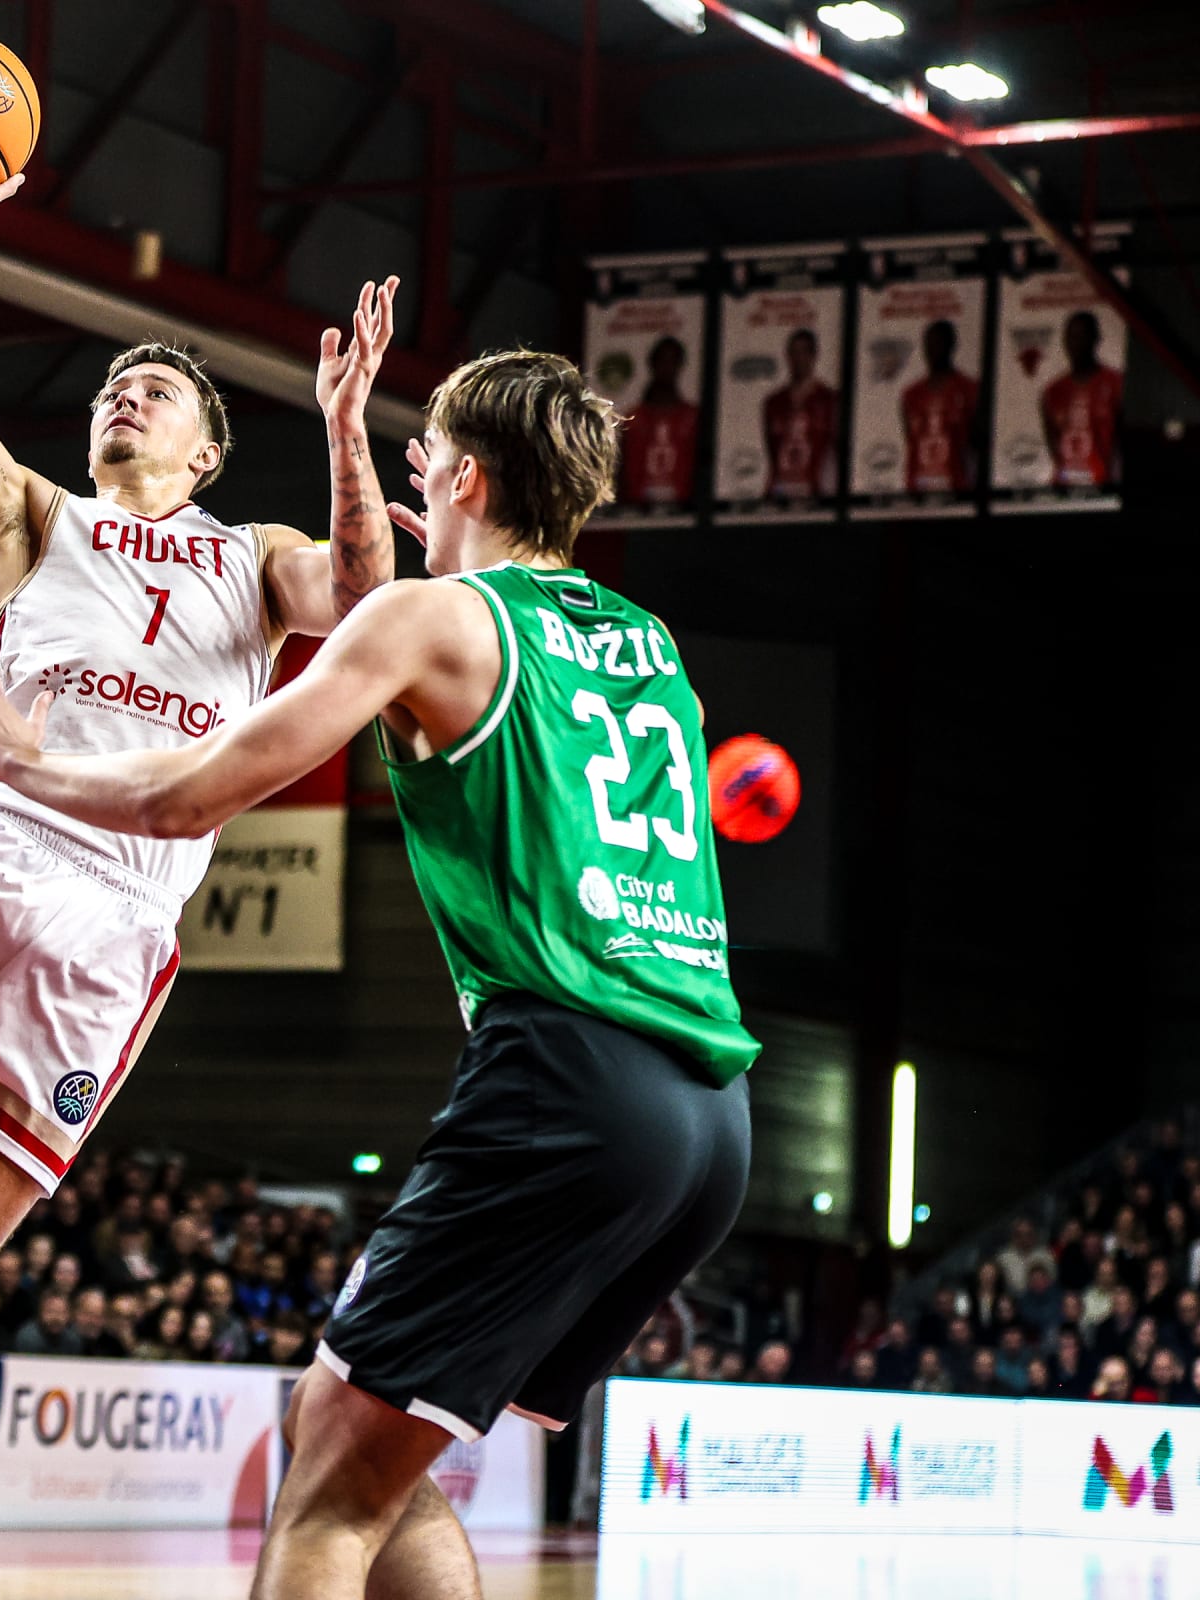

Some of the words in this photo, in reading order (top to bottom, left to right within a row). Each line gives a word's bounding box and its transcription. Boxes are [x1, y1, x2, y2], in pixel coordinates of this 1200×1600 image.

[141, 585, 171, 646] 7
[147, 715, 180, 732] expertise
[571, 688, 698, 861] 23
[615, 873, 654, 904] City
[657, 880, 676, 903] of
[7, 1385, 234, 1451] FOUGERAY
